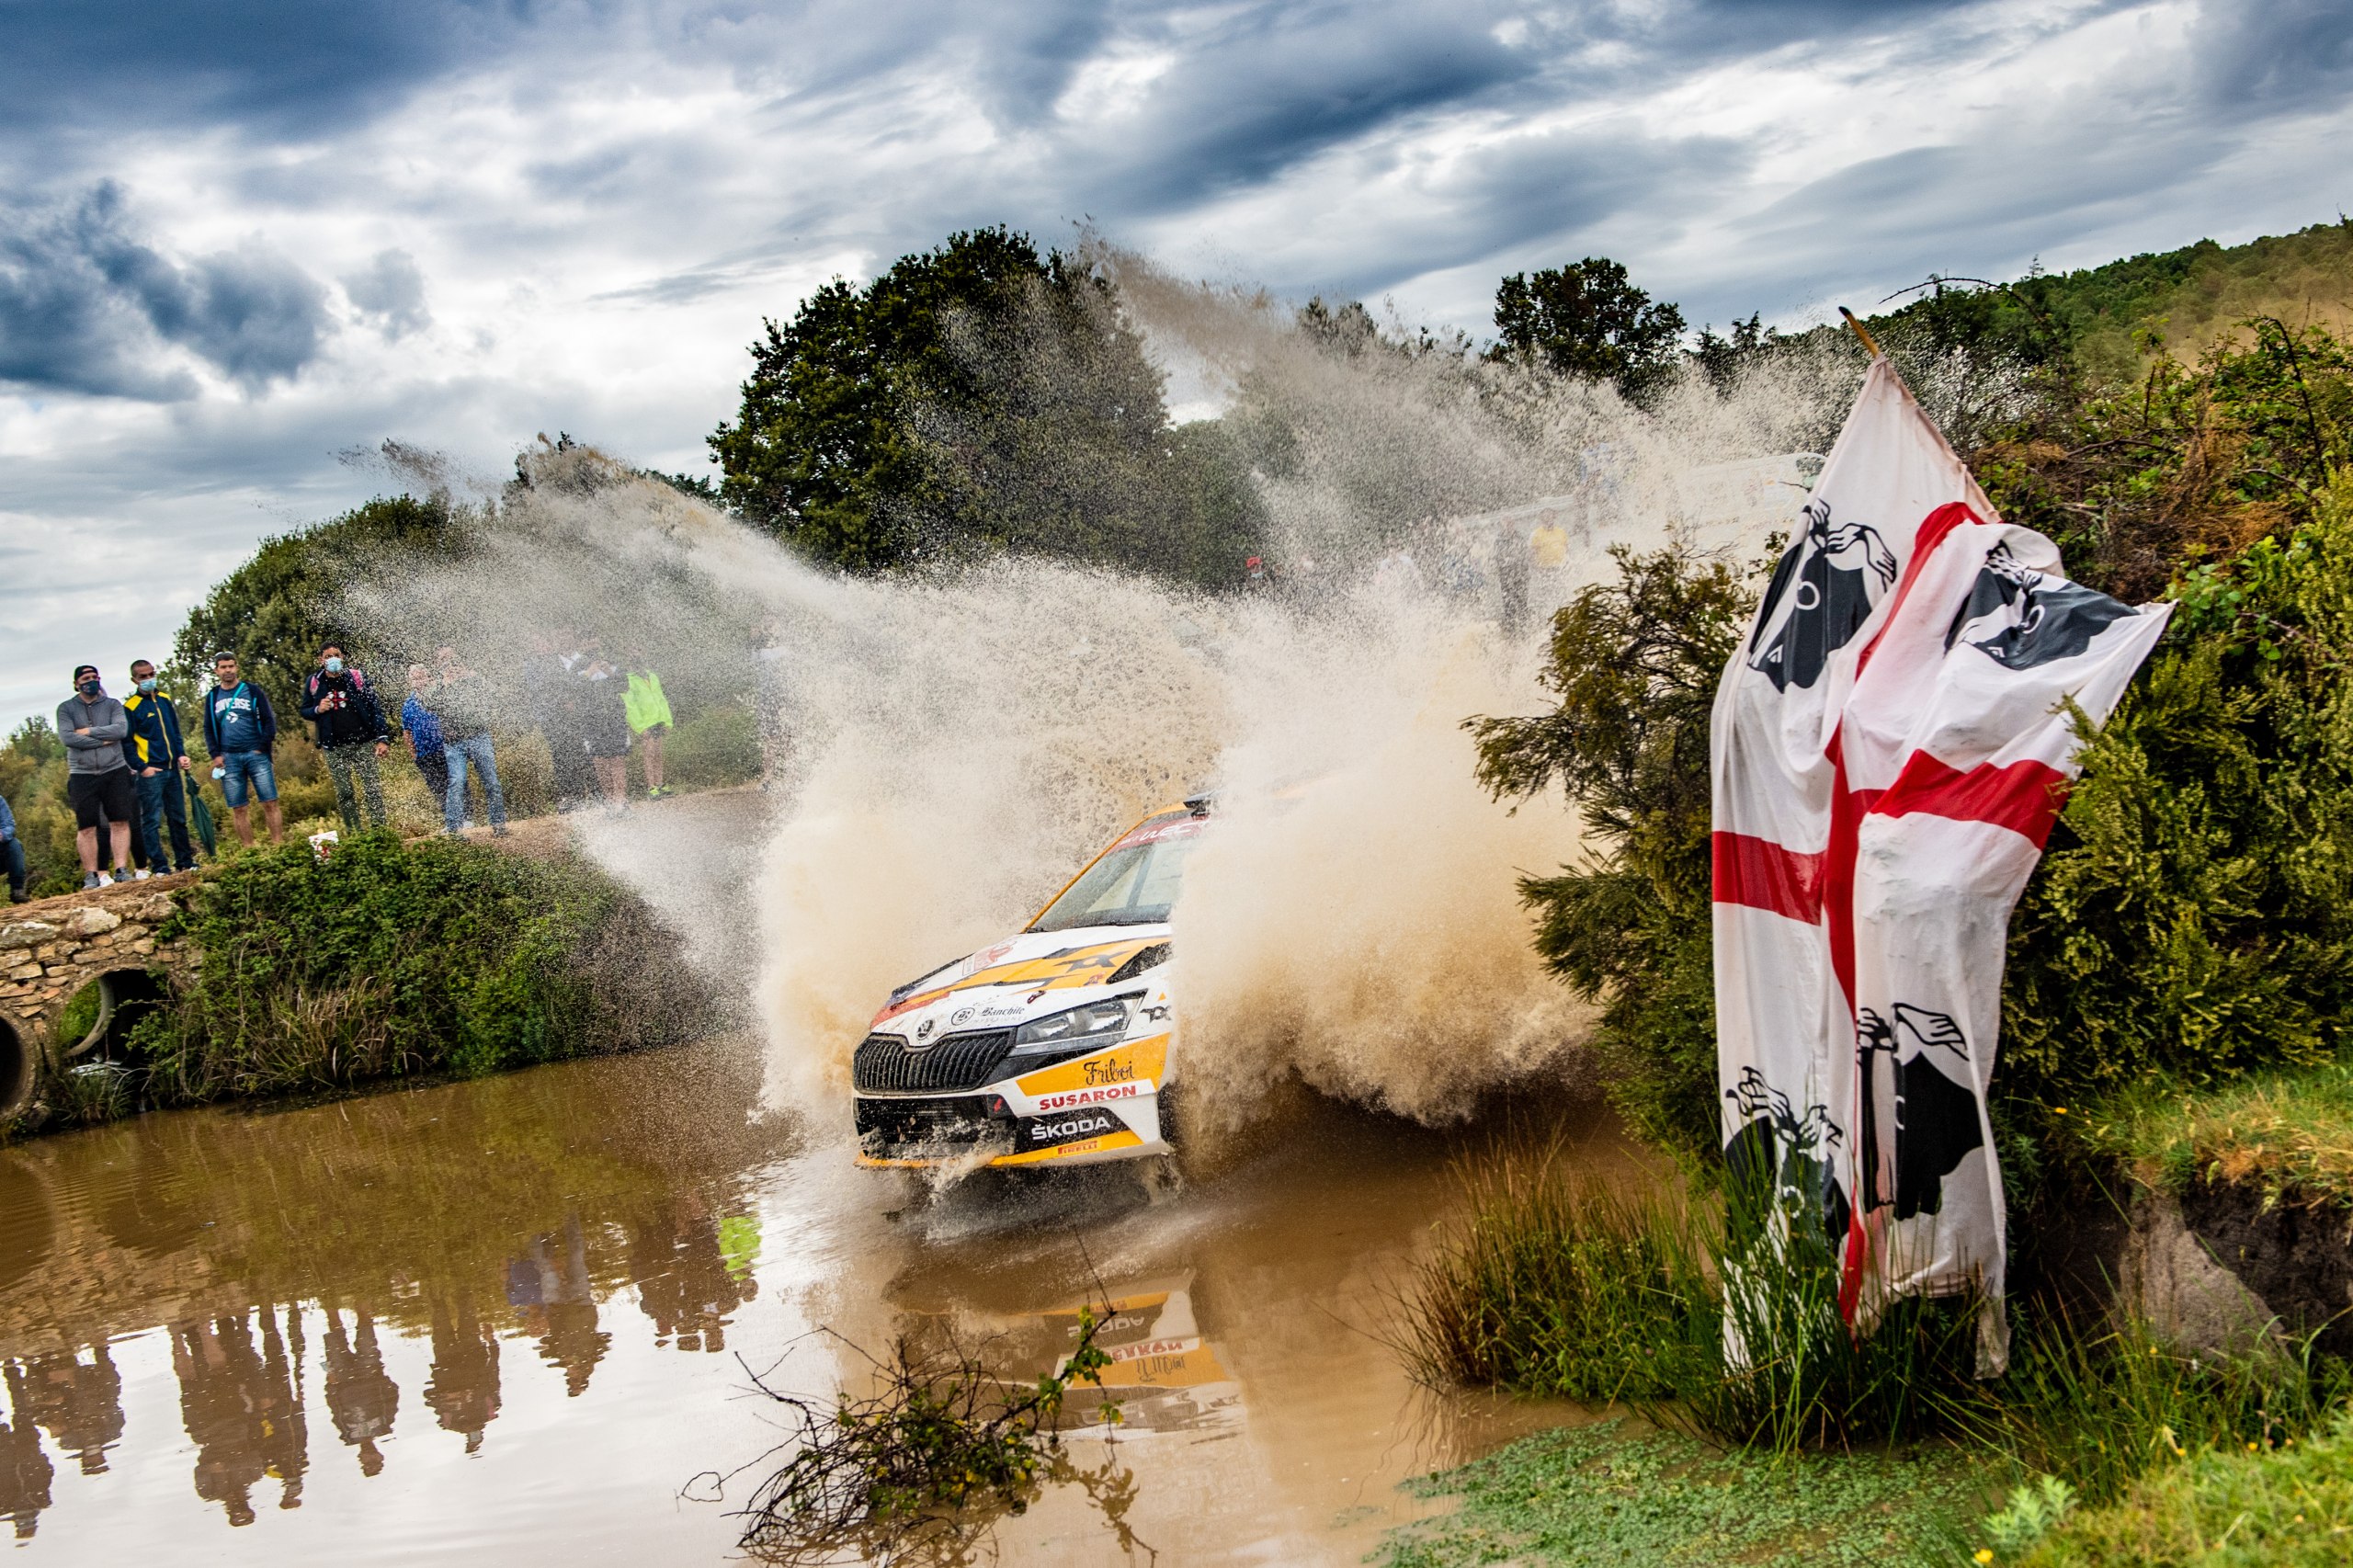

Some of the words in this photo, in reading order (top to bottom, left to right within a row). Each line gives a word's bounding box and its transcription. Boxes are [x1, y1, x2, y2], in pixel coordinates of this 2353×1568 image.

[982, 1006, 1025, 1017] Banchile
[1084, 1058, 1135, 1085] Friboi
[1040, 1085, 1136, 1110] SUSARON
[1031, 1116, 1111, 1141] ŠKODA
